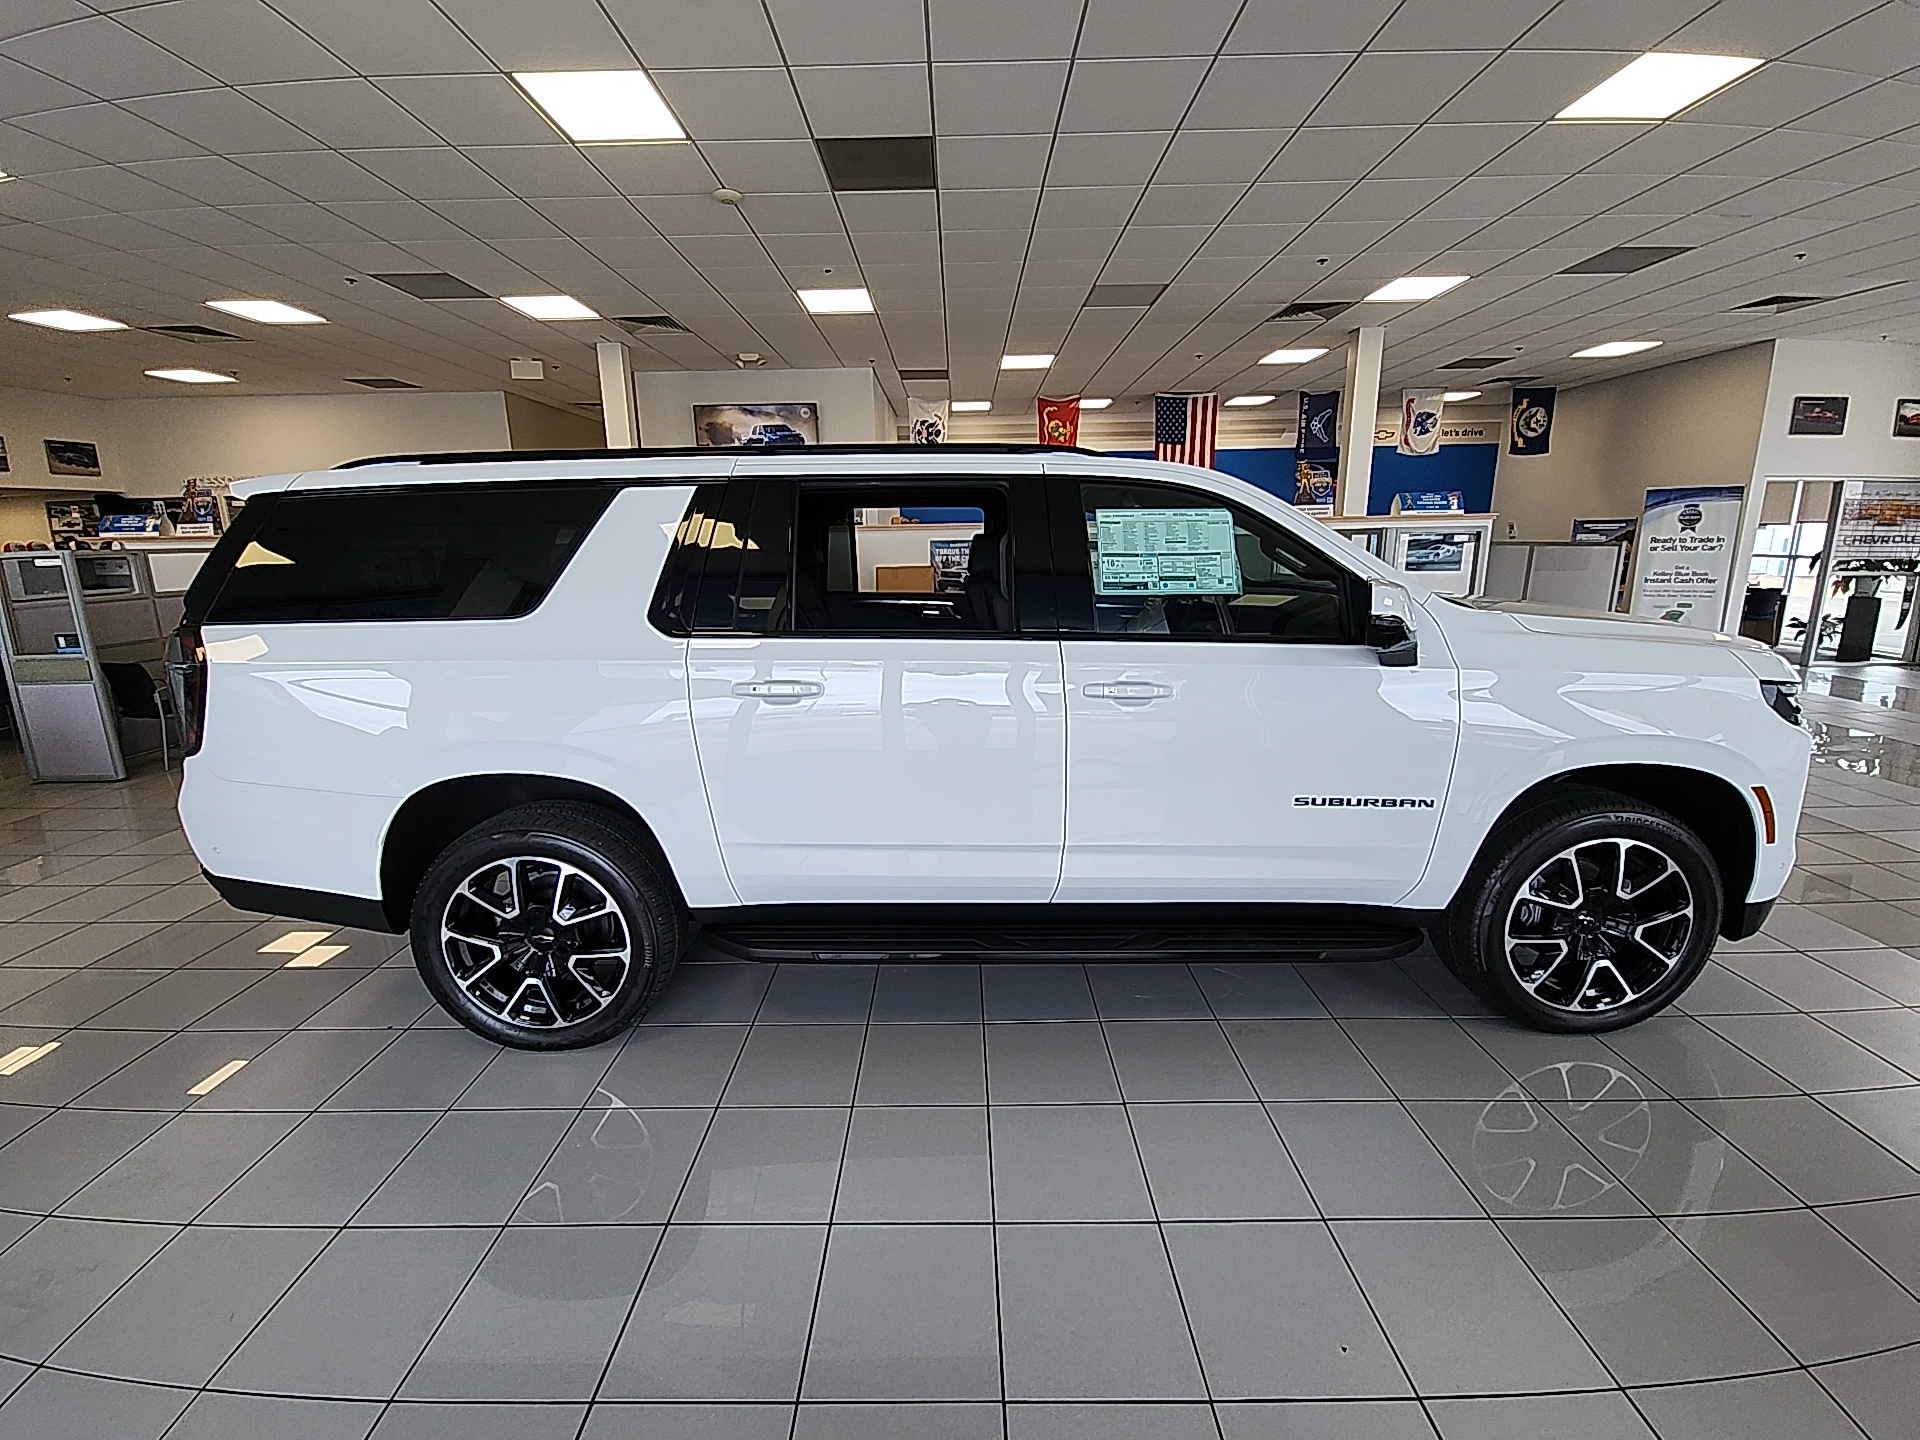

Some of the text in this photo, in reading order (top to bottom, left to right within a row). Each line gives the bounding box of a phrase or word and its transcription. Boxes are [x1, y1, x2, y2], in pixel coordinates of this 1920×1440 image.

[1441, 427, 1484, 437] let's drive
[1650, 536, 1677, 545] Ready
[1689, 536, 1715, 544] Trade
[1716, 536, 1726, 544] In
[1680, 544, 1700, 552] Your
[1701, 544, 1724, 552] Car?
[1293, 797, 1435, 808] SUBURBAN
